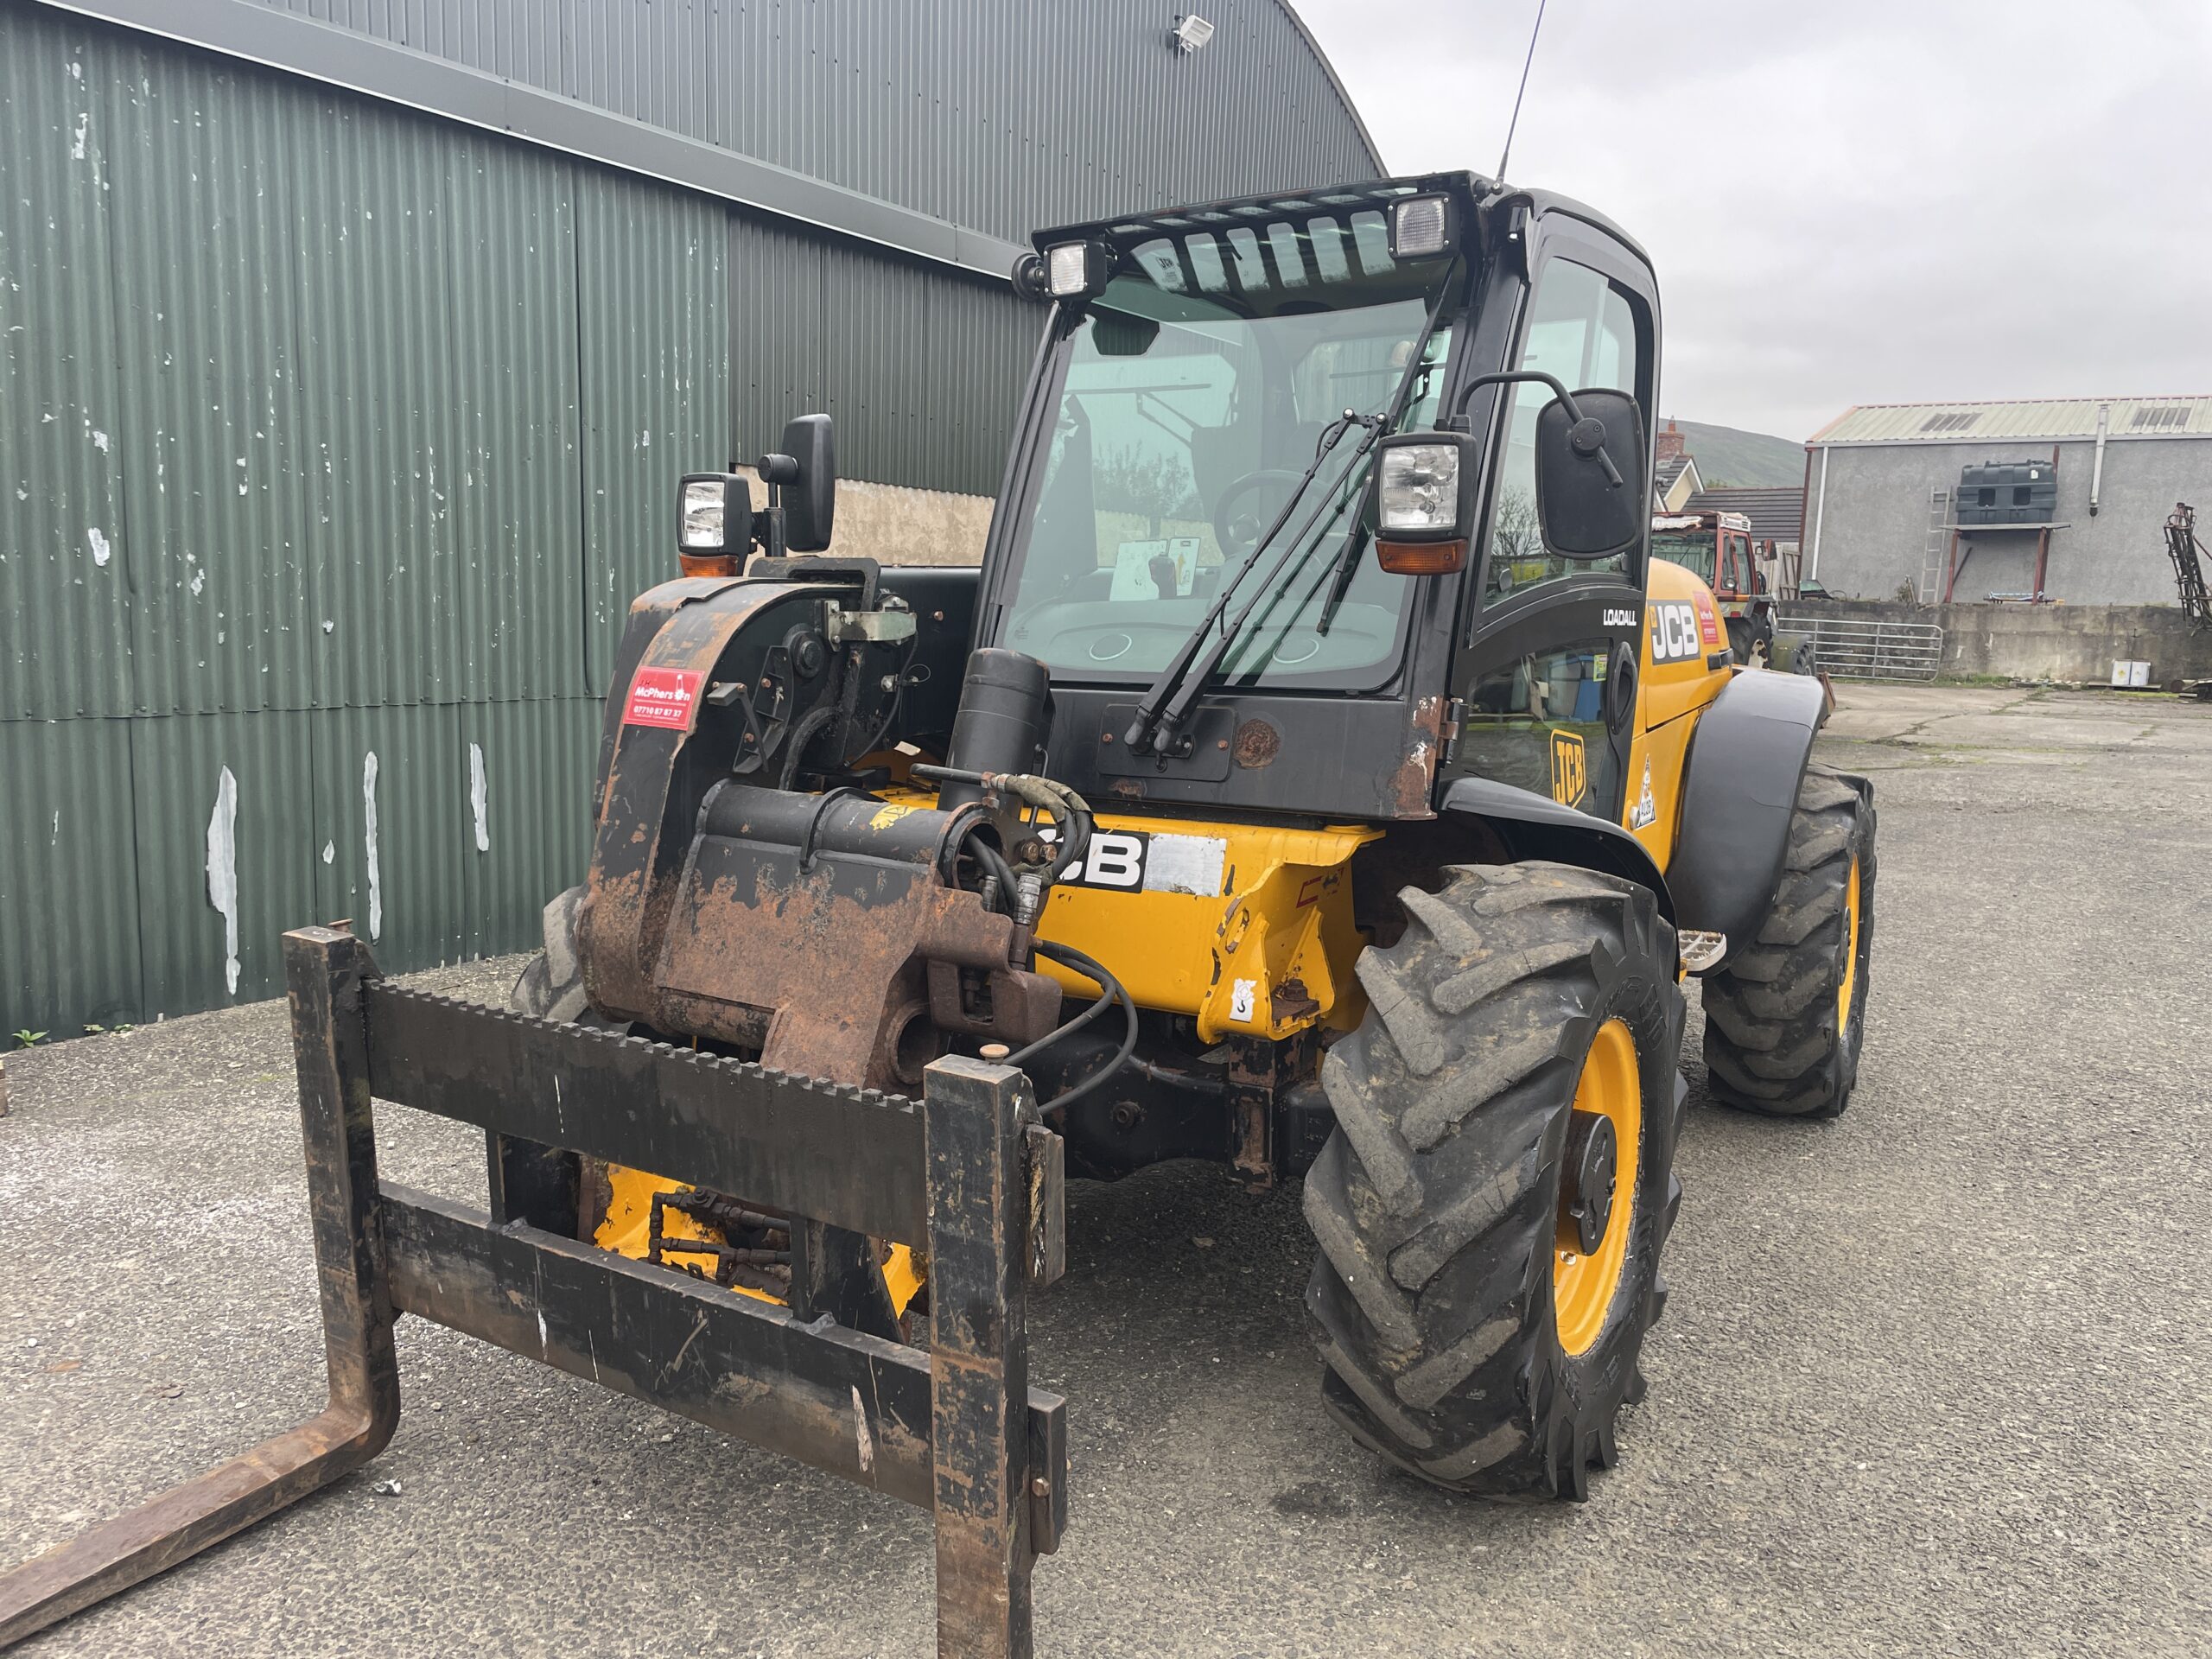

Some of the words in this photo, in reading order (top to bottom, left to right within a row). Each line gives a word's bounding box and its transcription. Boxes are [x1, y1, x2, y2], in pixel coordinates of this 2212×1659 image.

[1603, 608, 1637, 626] LOADALL
[1652, 605, 1699, 659] JCB
[633, 705, 654, 715] 07710
[1555, 741, 1584, 806] JCB
